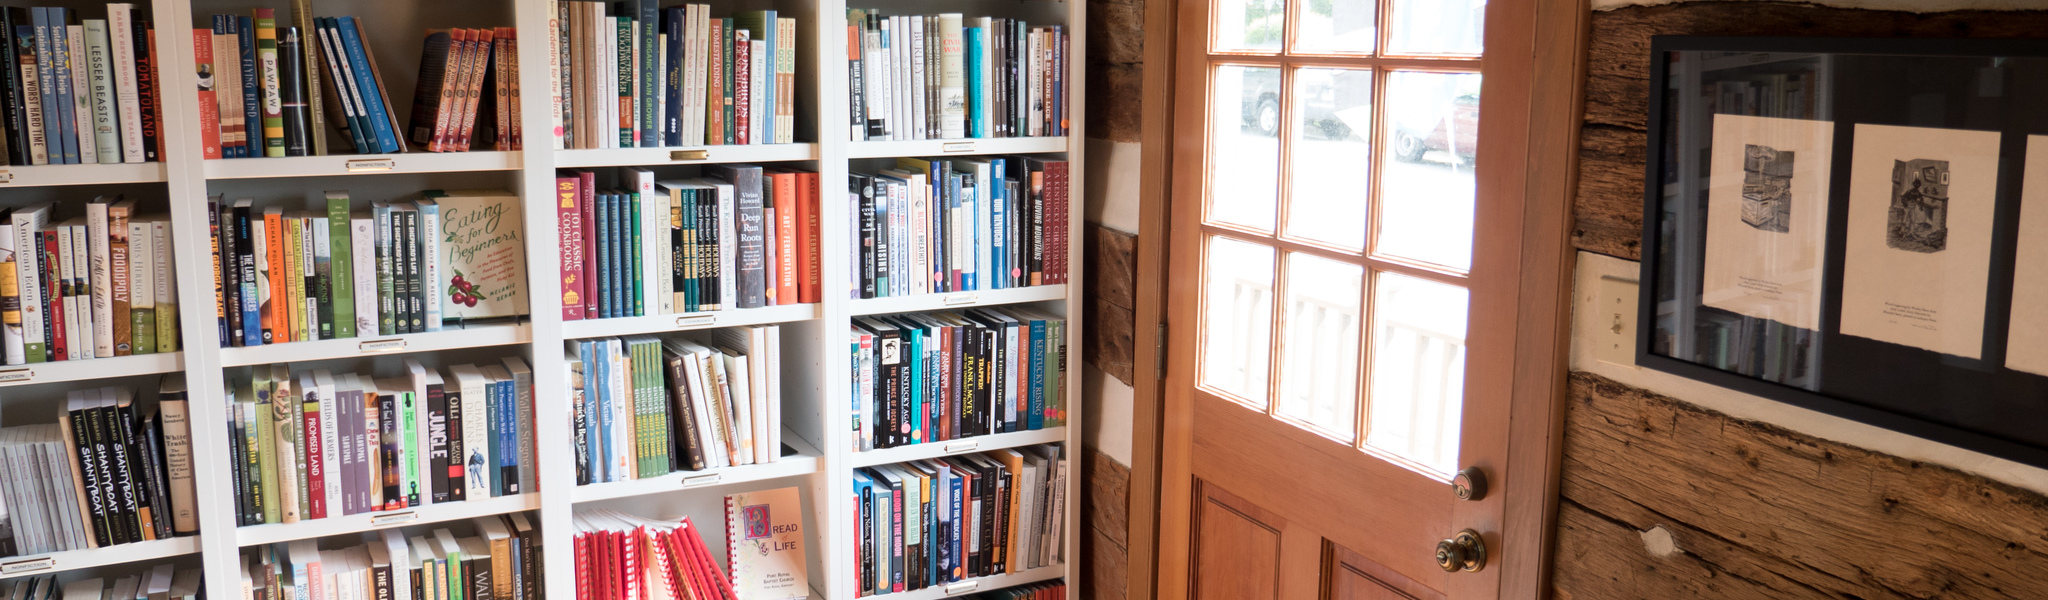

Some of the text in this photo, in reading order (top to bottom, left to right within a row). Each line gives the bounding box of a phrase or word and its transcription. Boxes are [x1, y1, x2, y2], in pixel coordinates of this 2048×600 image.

[37, 26, 49, 65] Sustainability
[549, 19, 559, 66] Gardening
[914, 31, 923, 76] BURLEY
[27, 80, 39, 104] WORST
[42, 76, 52, 94] Design
[91, 46, 108, 122] LESSER BEASTS
[243, 59, 254, 88] FLYING
[265, 60, 276, 107] PAWPAW
[741, 46, 749, 118] SONGBIRDS
[30, 107, 41, 126] HARD
[137, 57, 154, 137] TOMATOLAND
[246, 94, 257, 117] BLIND
[553, 96, 562, 118] Birds
[33, 130, 44, 147] TIME
[443, 202, 510, 235] Eating
[466, 228, 482, 244] for
[571, 213, 579, 230] 101
[722, 213, 730, 244] Kentucky
[741, 234, 762, 242] Roots
[742, 214, 760, 223] Deep
[743, 224, 758, 232] Run
[994, 199, 1003, 247] OUR KENTUCKY
[1034, 200, 1042, 261] MOVING MOUNTAINS
[19, 218, 35, 301] American Eden
[381, 226, 389, 261] SHEPHERD'S
[450, 230, 520, 266] Beginners
[562, 212, 572, 271] COOKBOOKS
[573, 231, 581, 271] CLASSIC
[878, 244, 887, 272] RISING
[113, 247, 127, 302] FOODOPOLY
[133, 233, 145, 306] JAMES HERRIOT'S
[156, 235, 166, 296] JAMES HERRIOT
[210, 236, 224, 317] THE GEORGIA PEACH
[244, 254, 257, 312] THE LAND GRABBERS
[232, 292, 240, 322] Upstream
[450, 397, 459, 419] OIL!
[465, 402, 474, 443] DICKENS
[475, 401, 484, 443] CHARLES
[575, 390, 588, 445] Kentucky's Best
[588, 401, 596, 427] Victuals
[704, 365, 724, 441] Appalachian Home Cooking
[308, 417, 319, 476] PROMISED LAND
[323, 398, 335, 461] FIELDS OF FARMERS
[429, 411, 448, 459] JUNGLE
[520, 391, 531, 468] Wallace Stegner
[683, 408, 693, 428] Servant's
[689, 429, 697, 449] Directory
[90, 411, 118, 513] HUBBARD SHANTYBOAT
[107, 411, 136, 512] HUBBARD SHANTYBOAT
[893, 490, 901, 512] BLOOD
[894, 512, 901, 522] ON
[864, 501, 873, 563] Camp Nelson, Kentucky
[984, 494, 993, 552] HENRY CLAY
[12, 562, 47, 570] NONFICTION
[774, 541, 796, 551] LIFE
[894, 536, 902, 557] MOON
[378, 571, 387, 587] THE
